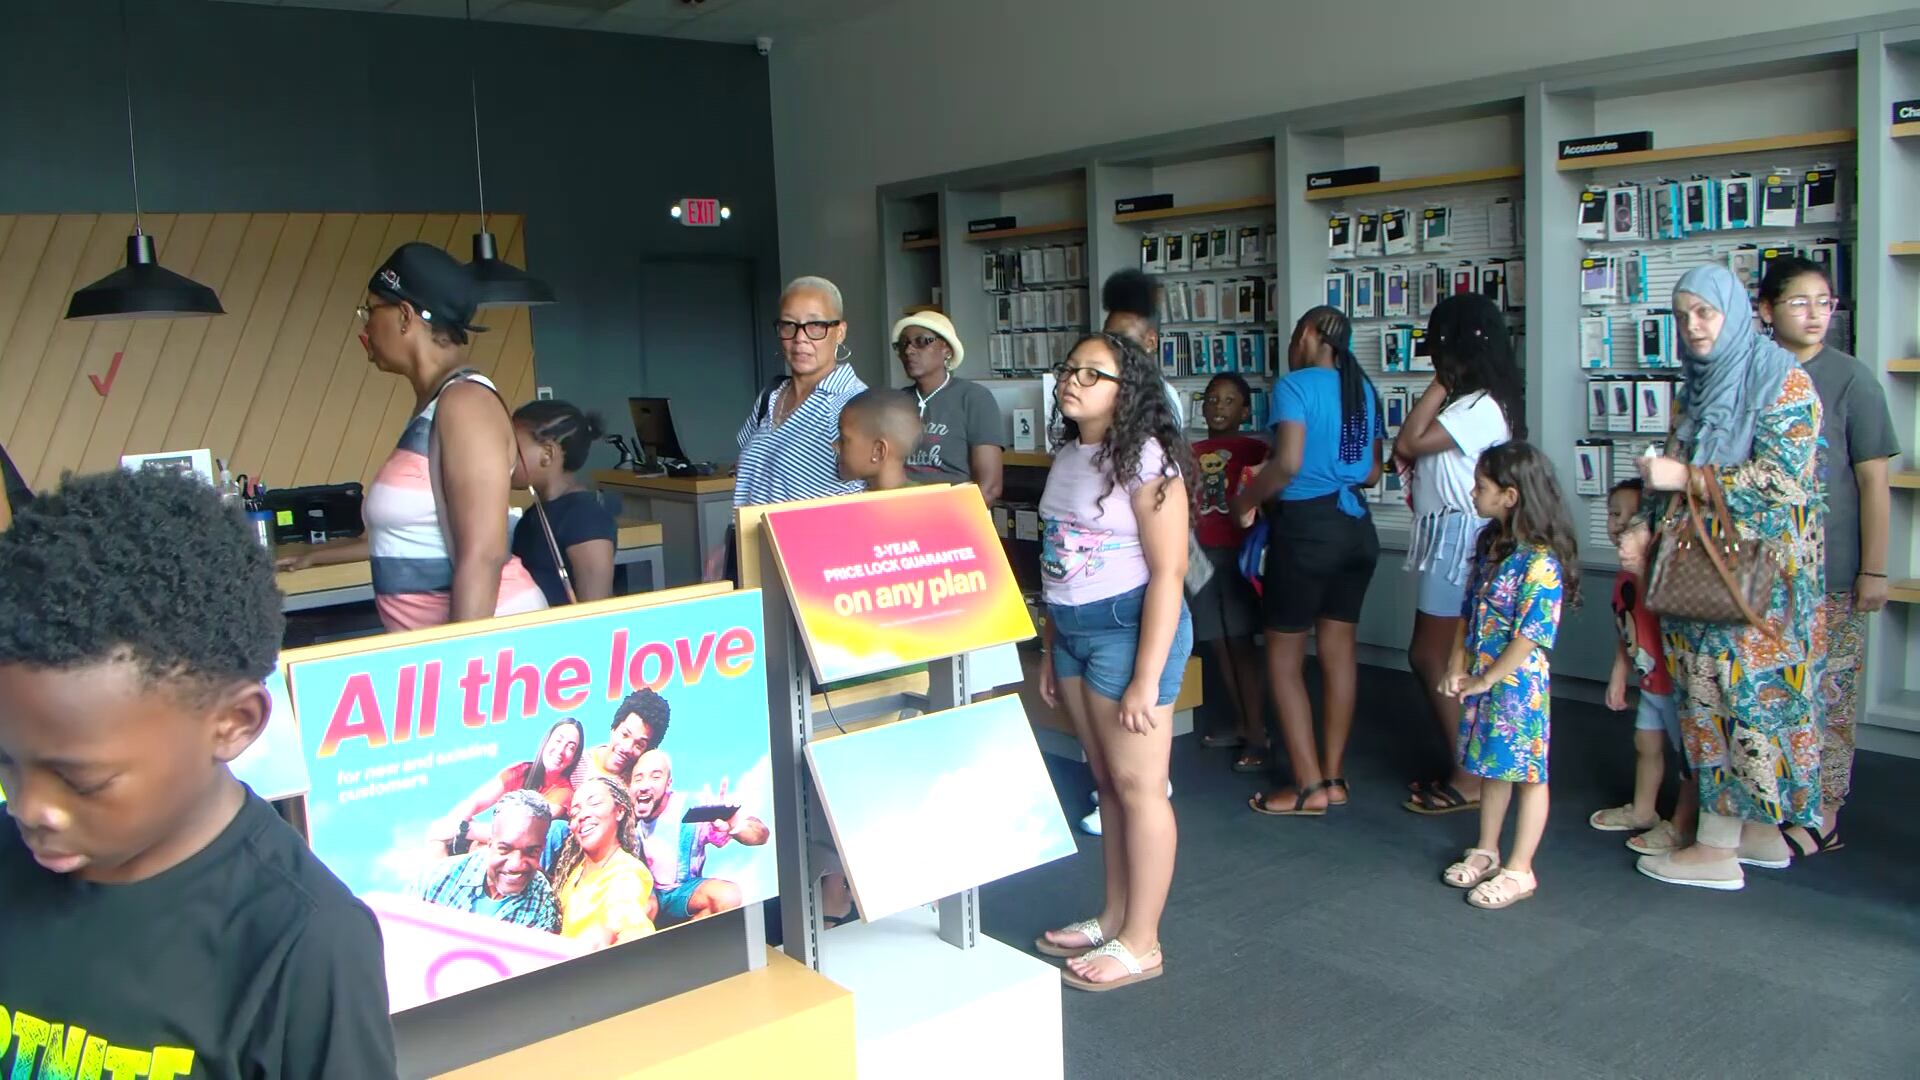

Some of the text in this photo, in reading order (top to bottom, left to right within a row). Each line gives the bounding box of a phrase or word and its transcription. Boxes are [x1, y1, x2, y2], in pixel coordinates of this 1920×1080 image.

[1563, 141, 1618, 155] Accessories
[687, 199, 715, 224] EXIT
[873, 540, 920, 558] 3-YEAR
[823, 547, 976, 582] PRICE LOCK GUARANTEE
[833, 568, 986, 616] on any plan
[317, 626, 755, 757] All the love
[337, 770, 361, 785] for
[365, 764, 399, 779] new
[403, 753, 433, 771] and
[338, 774, 428, 803] customers
